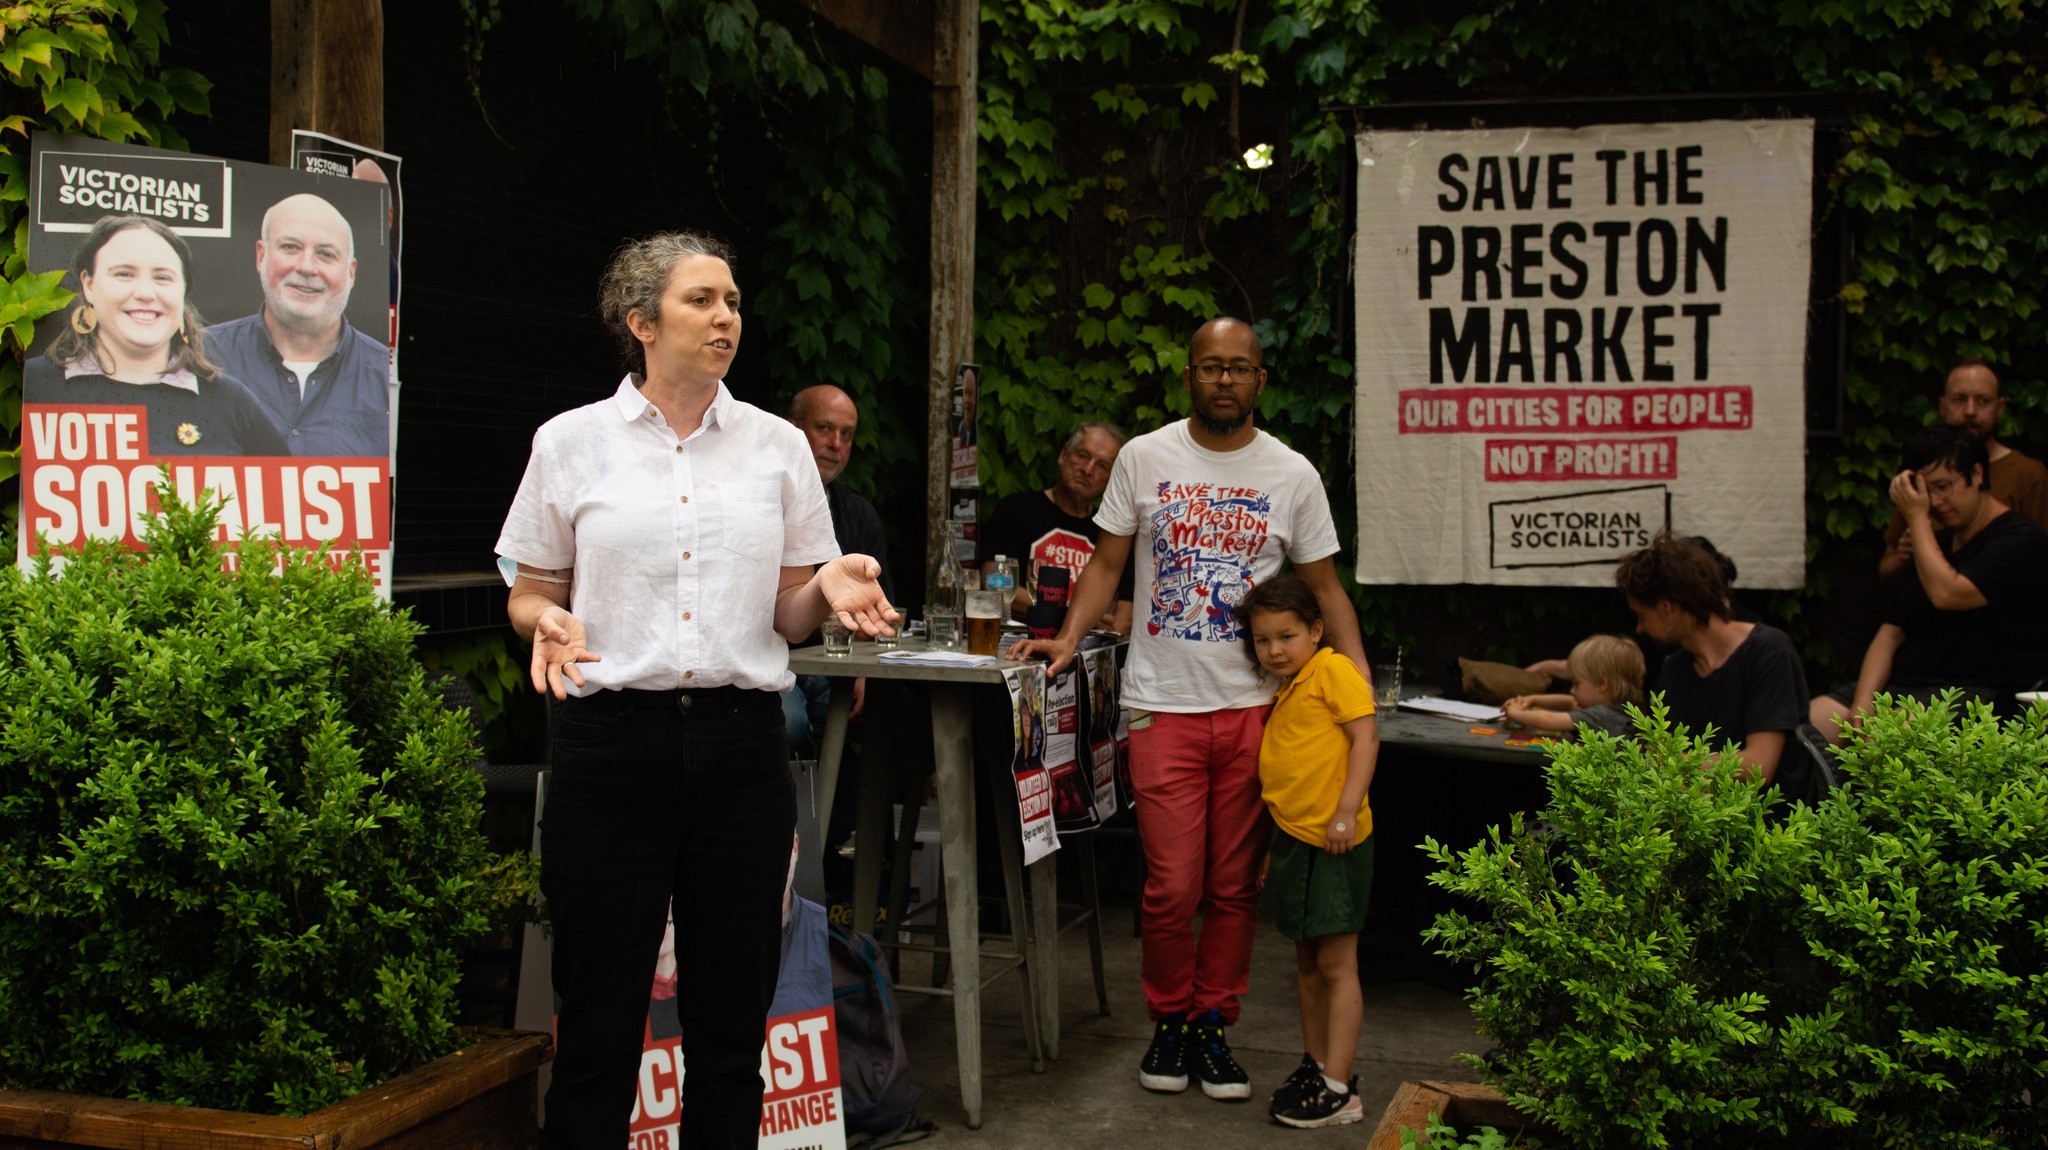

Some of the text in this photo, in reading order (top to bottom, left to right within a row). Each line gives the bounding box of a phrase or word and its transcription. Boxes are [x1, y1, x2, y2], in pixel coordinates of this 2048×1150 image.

[59, 165, 200, 202] VICTORIAN
[306, 156, 348, 175] VICTORIAN
[1438, 145, 1703, 212] SAVE THE
[59, 185, 209, 222] SOCIALISTS
[1418, 216, 1728, 301] PRESTON
[1429, 303, 1722, 384] MARKET
[1405, 392, 1749, 428] OUR CITIES FOR PEOPLE,
[29, 412, 139, 461] VOTE
[1490, 443, 1668, 475] NOT PROFIT!
[1160, 484, 1260, 504] SAVE THE
[1510, 512, 1641, 530] VICTORIAN
[1510, 529, 1650, 549] SOCIALISTS
[760, 1091, 837, 1137] HANGE
